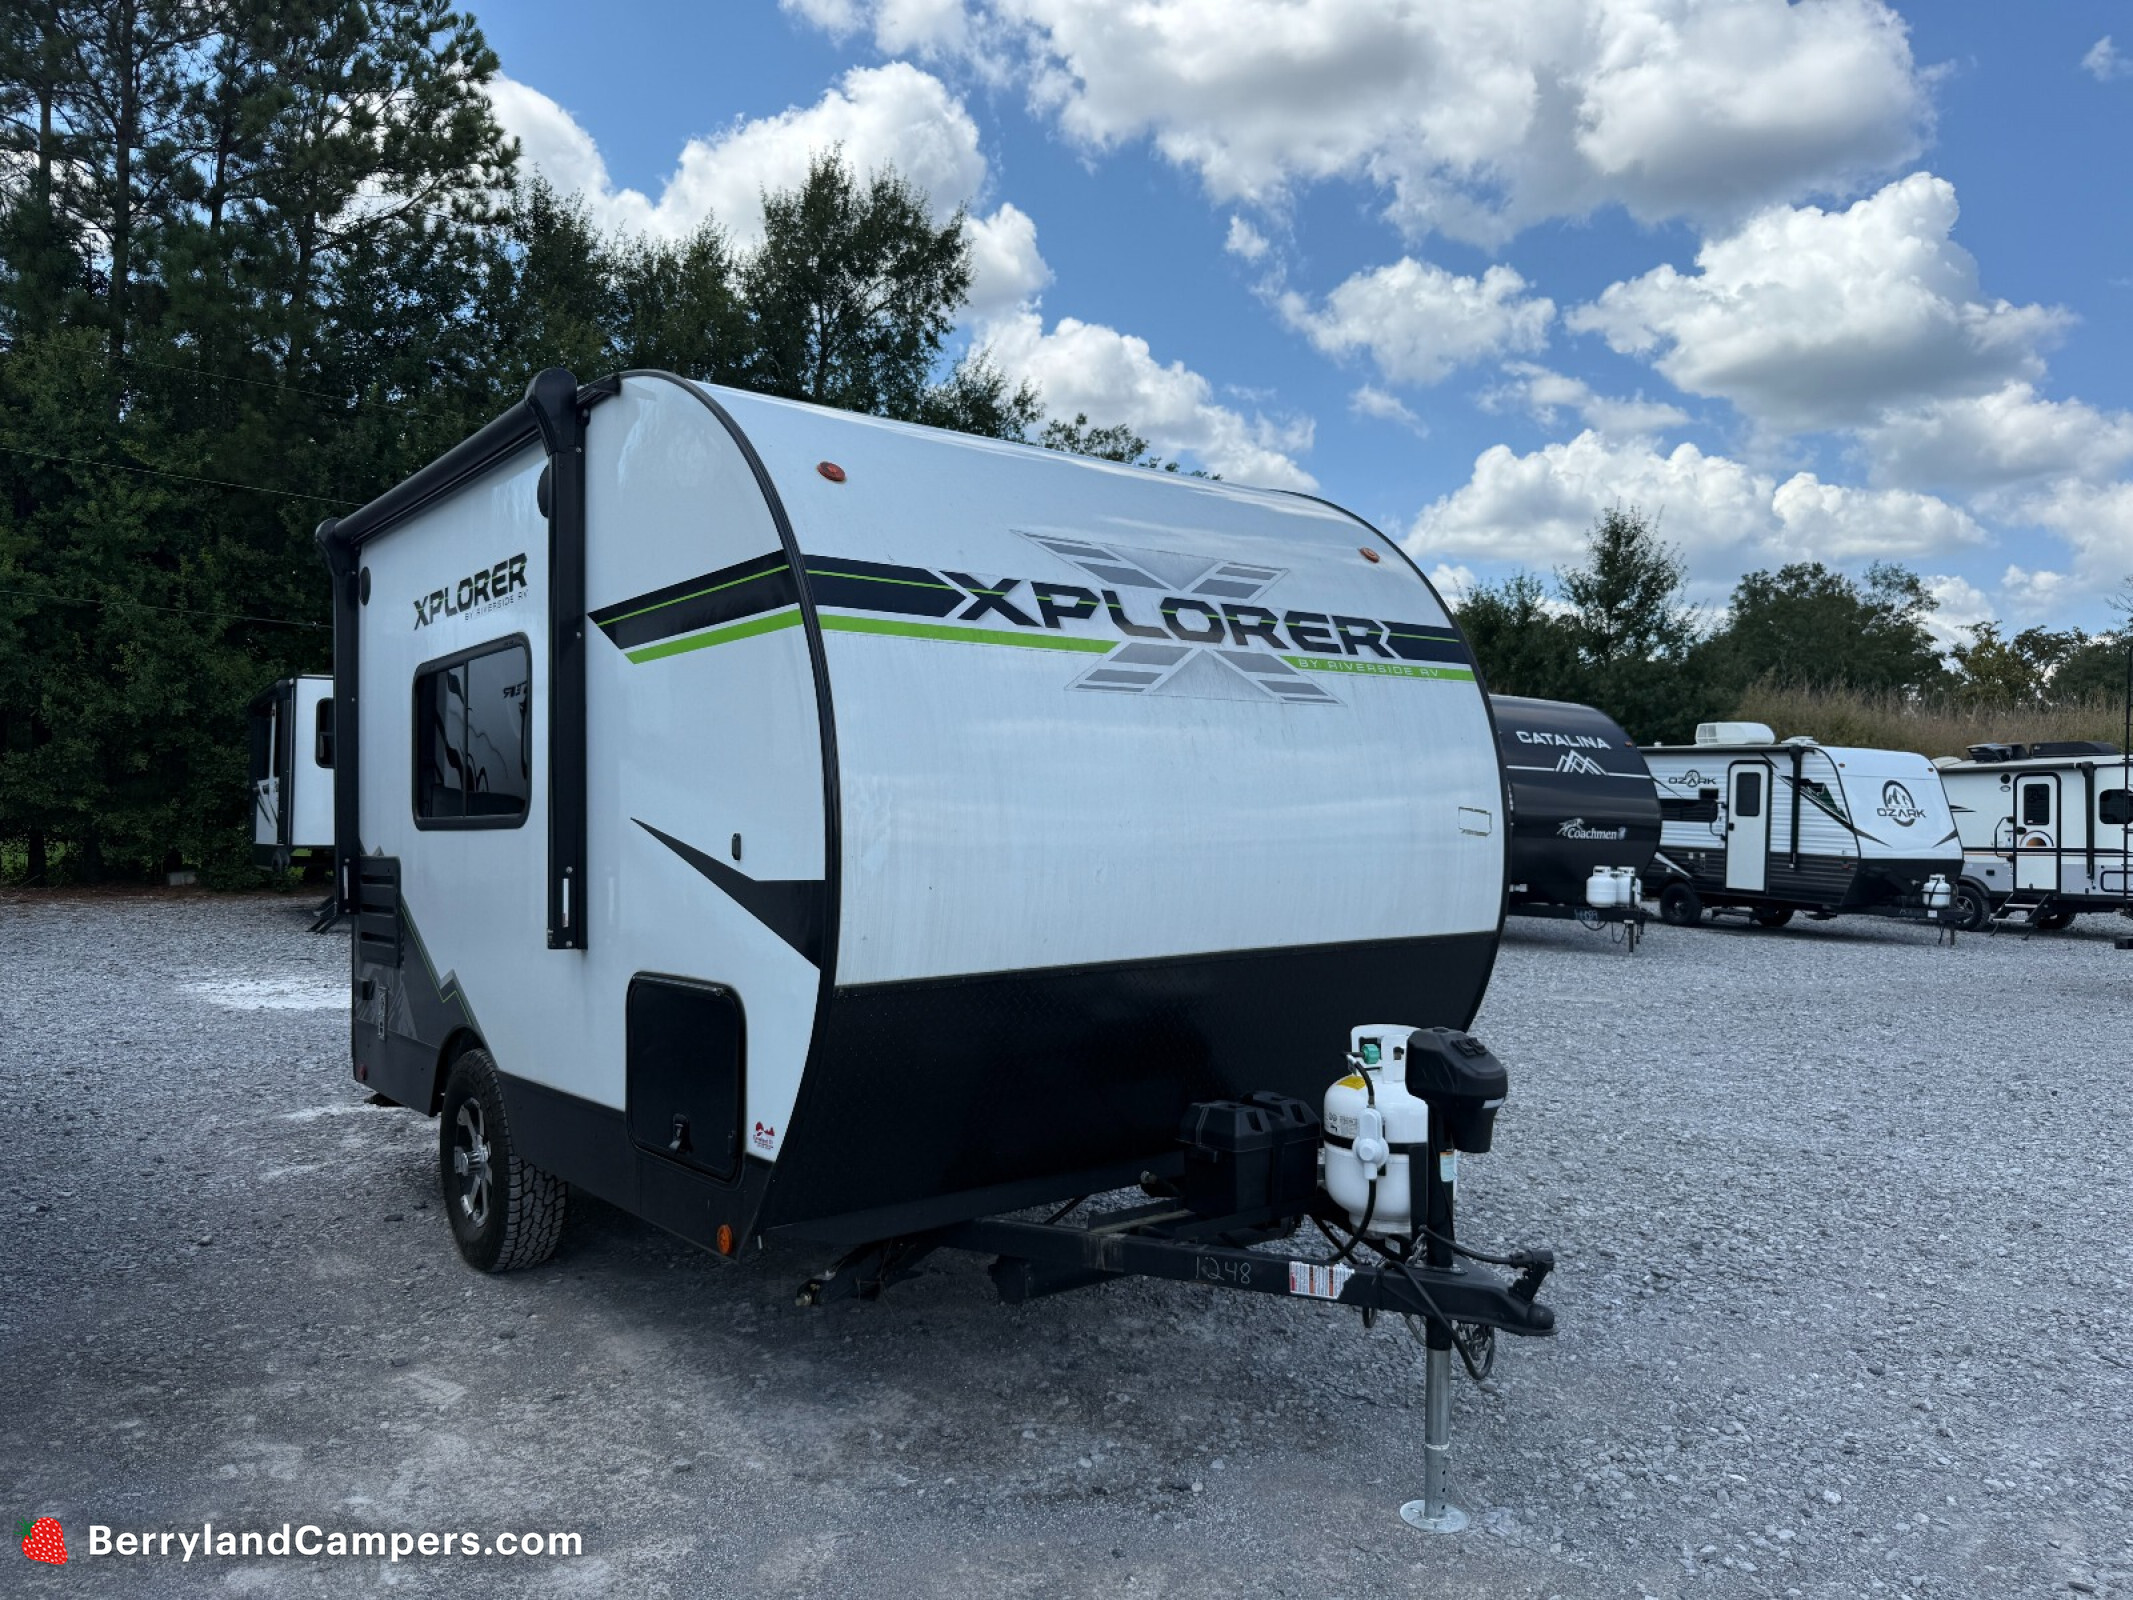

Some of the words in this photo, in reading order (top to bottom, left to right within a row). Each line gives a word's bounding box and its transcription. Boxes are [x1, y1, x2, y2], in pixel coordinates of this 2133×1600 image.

[413, 553, 528, 630] XPLORER
[476, 596, 515, 617] RIVERSIDE
[938, 570, 1398, 659] XPLORER
[1299, 658, 1318, 669] BY
[1327, 660, 1414, 677] RIVERSIDE
[1420, 667, 1439, 678] RV
[1515, 730, 1612, 750] CATALINA
[1876, 807, 1927, 818] OZARK
[1567, 827, 1617, 840] Coachmen
[1195, 1255, 1251, 1285] 1248
